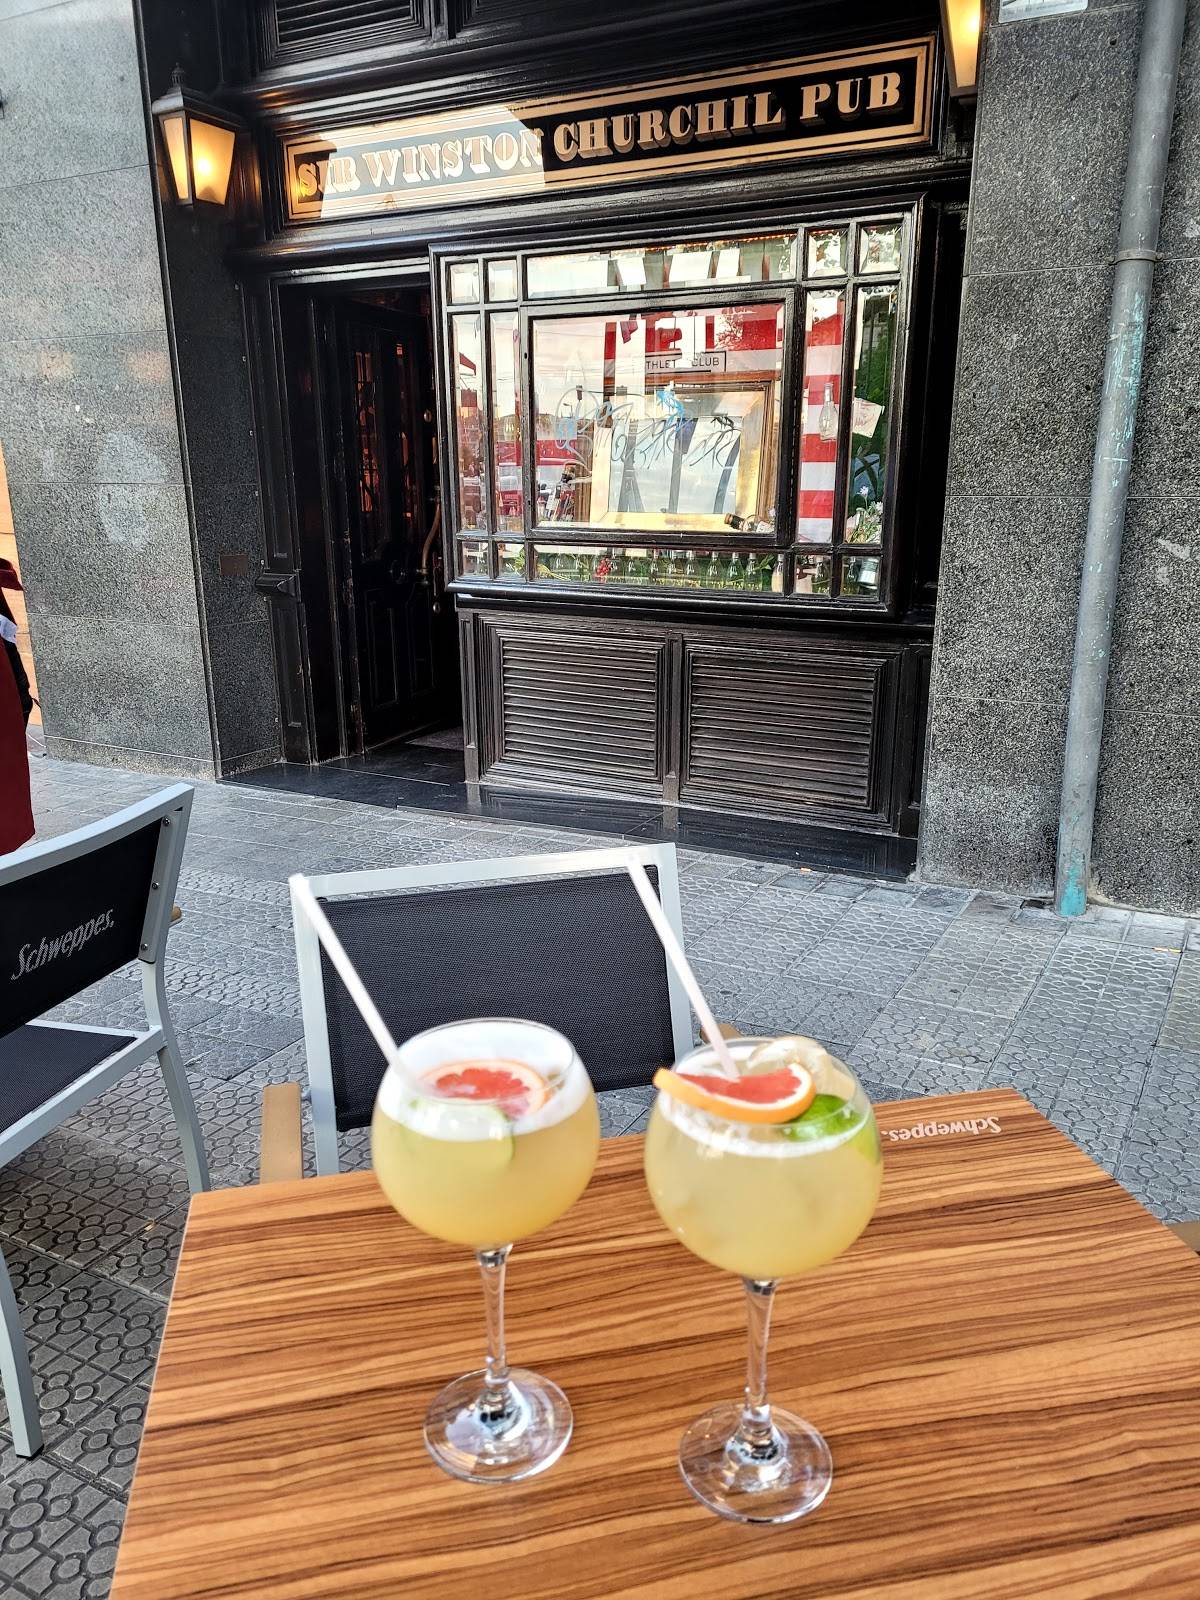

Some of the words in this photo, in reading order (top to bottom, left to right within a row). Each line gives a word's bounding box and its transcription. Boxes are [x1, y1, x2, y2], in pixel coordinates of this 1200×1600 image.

[297, 156, 361, 197] SIR
[362, 128, 545, 187] WINSTON
[553, 91, 786, 161] CHURCHIL
[800, 71, 902, 127] PUB
